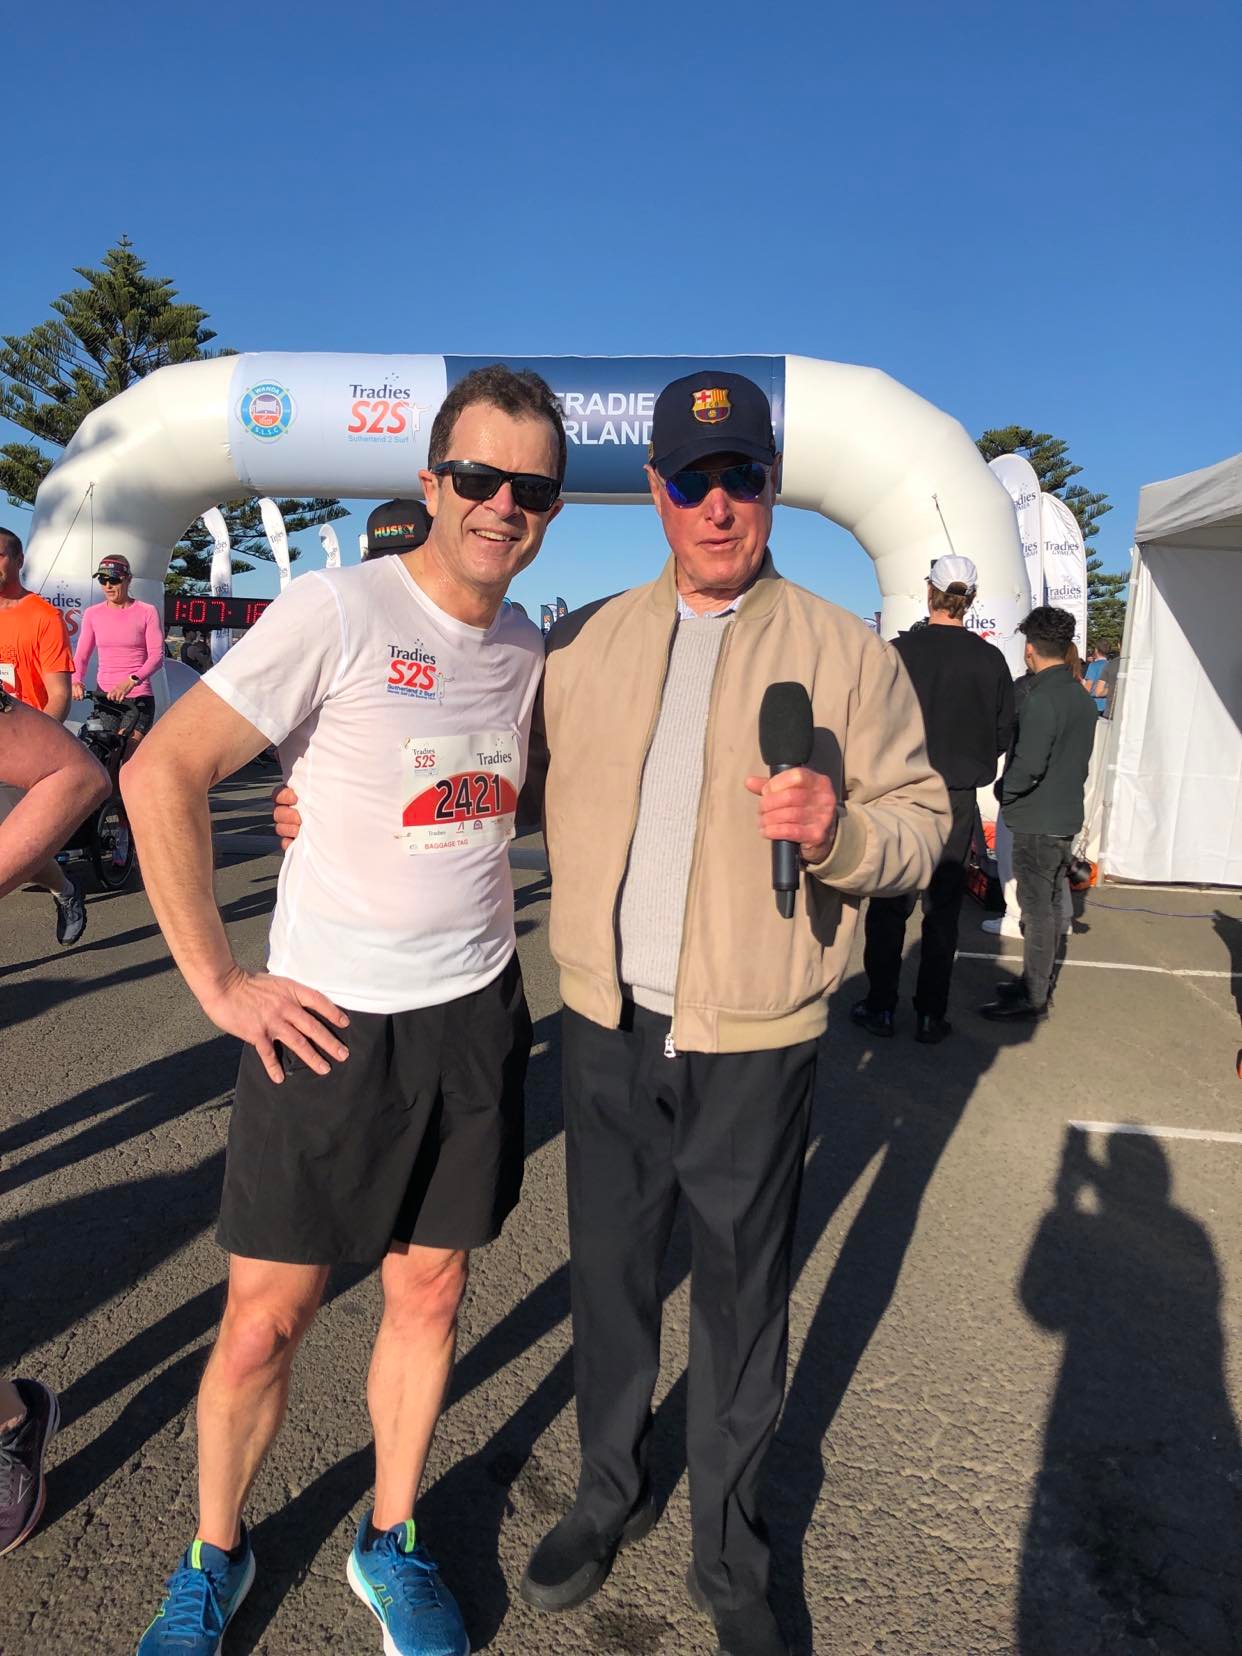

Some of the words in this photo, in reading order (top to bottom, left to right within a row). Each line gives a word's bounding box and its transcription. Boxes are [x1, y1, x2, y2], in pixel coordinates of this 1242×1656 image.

[349, 384, 411, 399] Tradies
[553, 392, 660, 416] RADIE
[347, 400, 410, 434] S2S
[1044, 540, 1080, 552] Tradies
[387, 644, 436, 665] Tradies
[388, 659, 436, 690] S2S
[414, 754, 436, 769] S2S
[477, 750, 513, 766] Tradies
[435, 773, 501, 820] 2421
[424, 841, 456, 850] BAGGAGE
